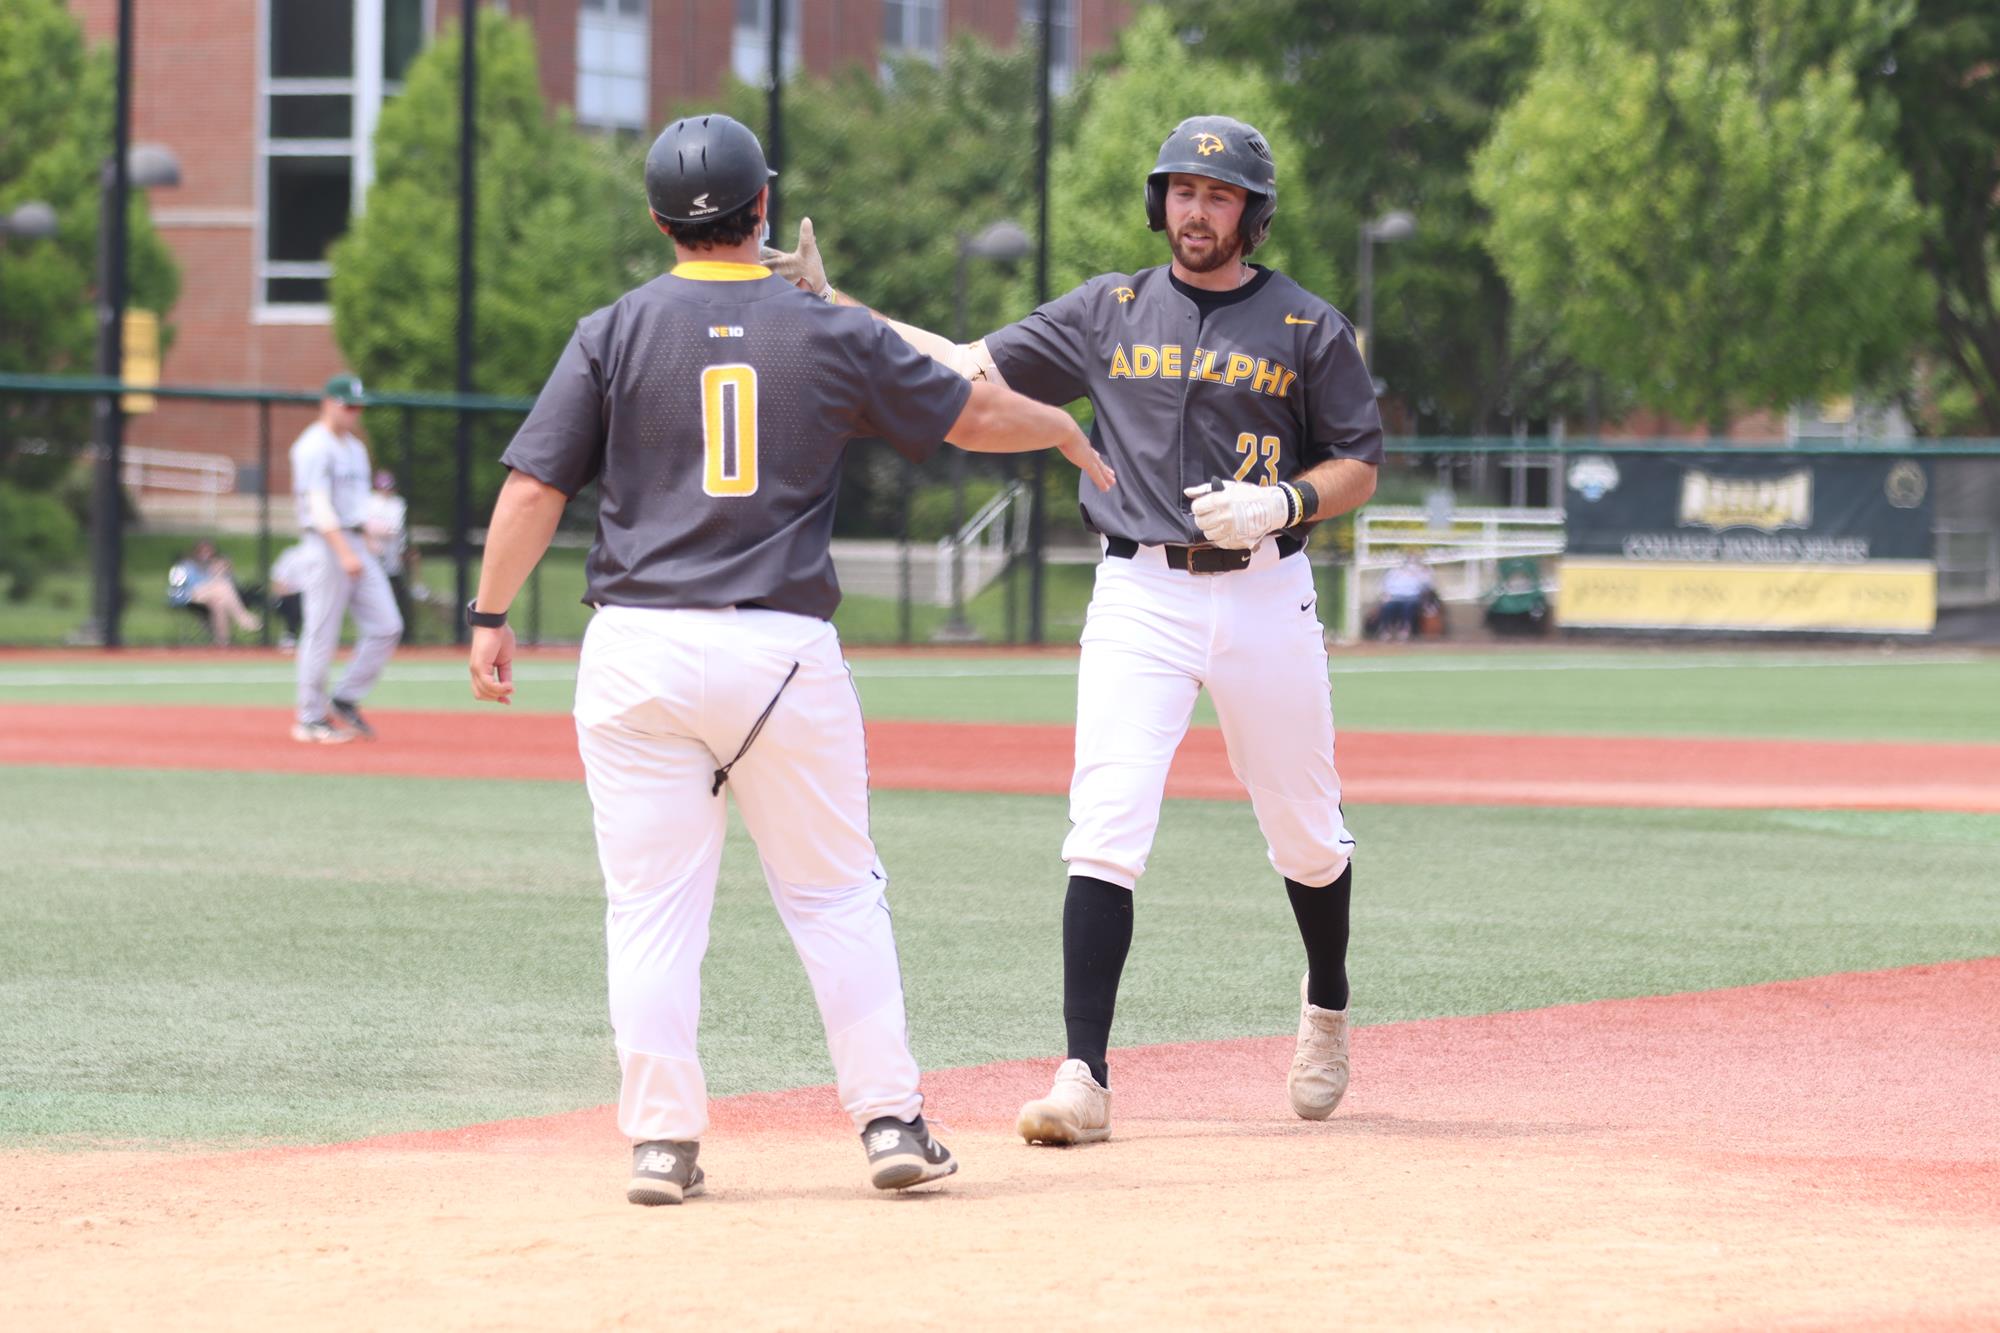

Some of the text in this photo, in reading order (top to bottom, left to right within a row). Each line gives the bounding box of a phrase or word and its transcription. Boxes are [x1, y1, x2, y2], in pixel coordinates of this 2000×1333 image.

[1108, 342, 1297, 397] ADELPHI
[700, 363, 758, 497] 0
[1233, 432, 1281, 487] 23
